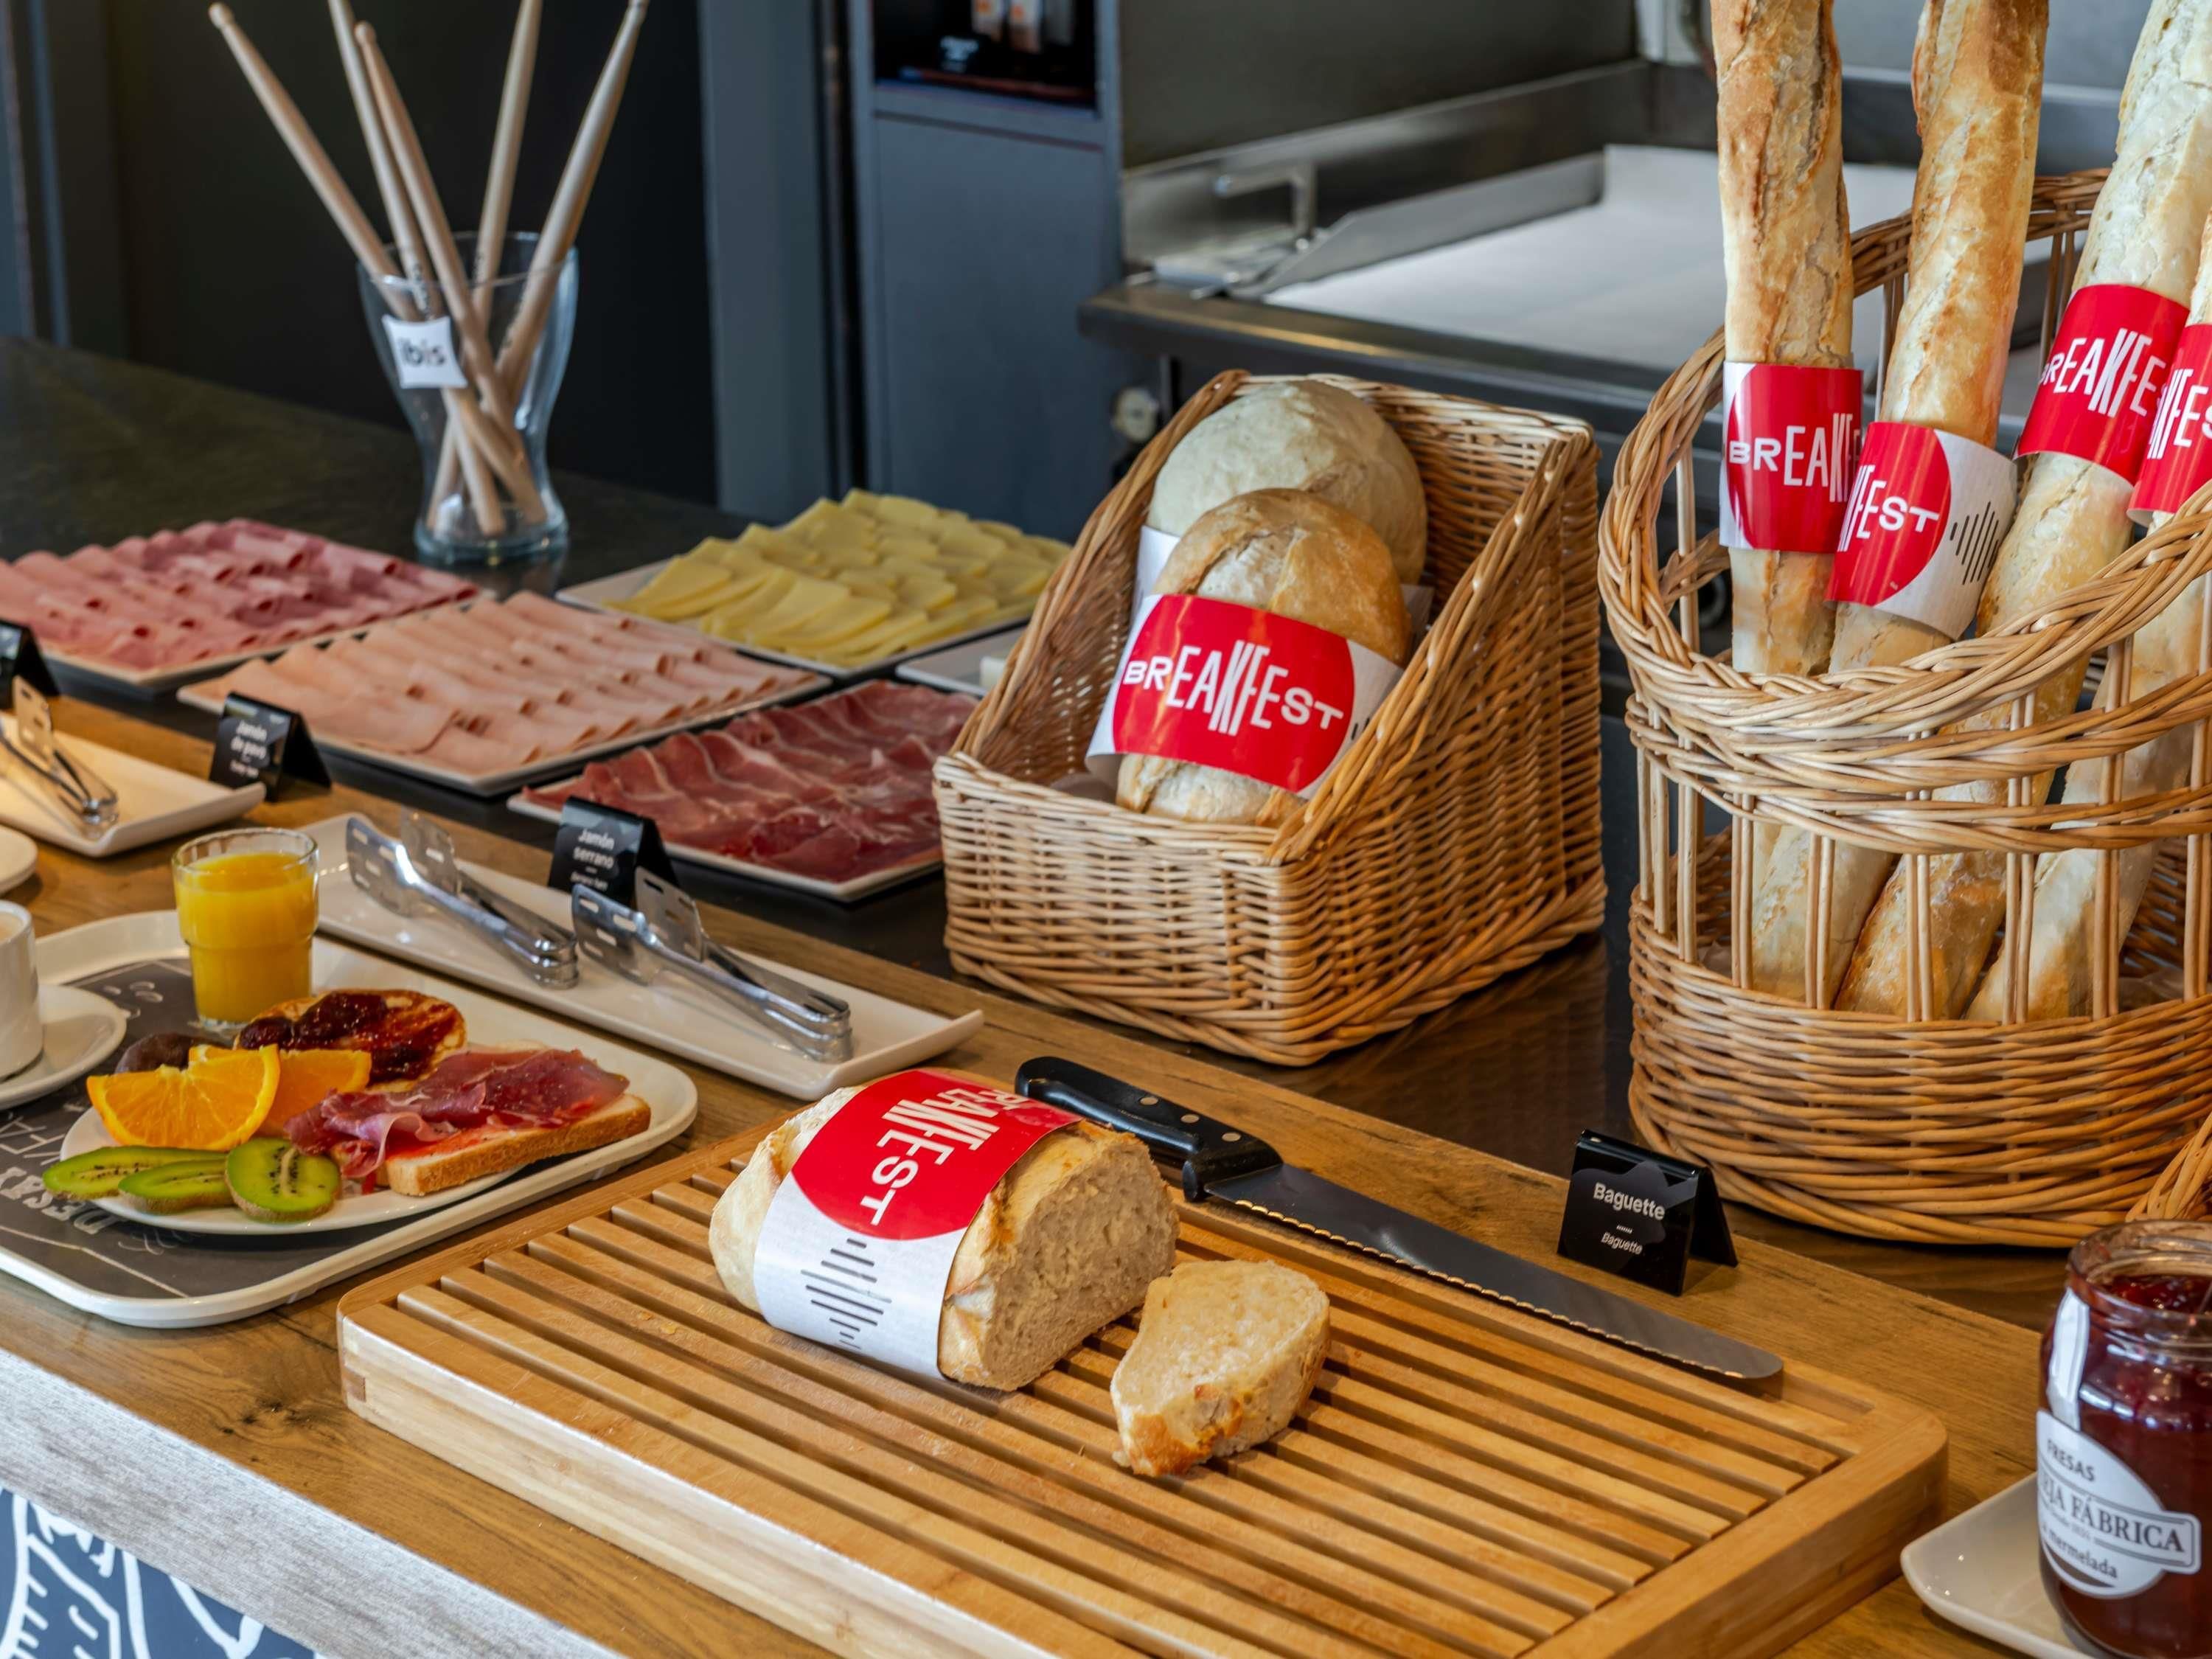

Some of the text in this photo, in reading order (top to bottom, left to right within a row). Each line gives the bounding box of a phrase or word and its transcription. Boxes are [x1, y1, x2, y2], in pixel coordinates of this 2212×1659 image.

[1122, 639, 1344, 737] BREAKFEST
[578, 828, 614, 851] Jamón
[1593, 1181, 1666, 1221] Baguette
[1600, 1232, 1644, 1255] Baguette
[2047, 1439, 2096, 1483] FRESAS
[2071, 1495, 2185, 1554] FÁBRICA
[2049, 1529, 2118, 1579] mermelada
